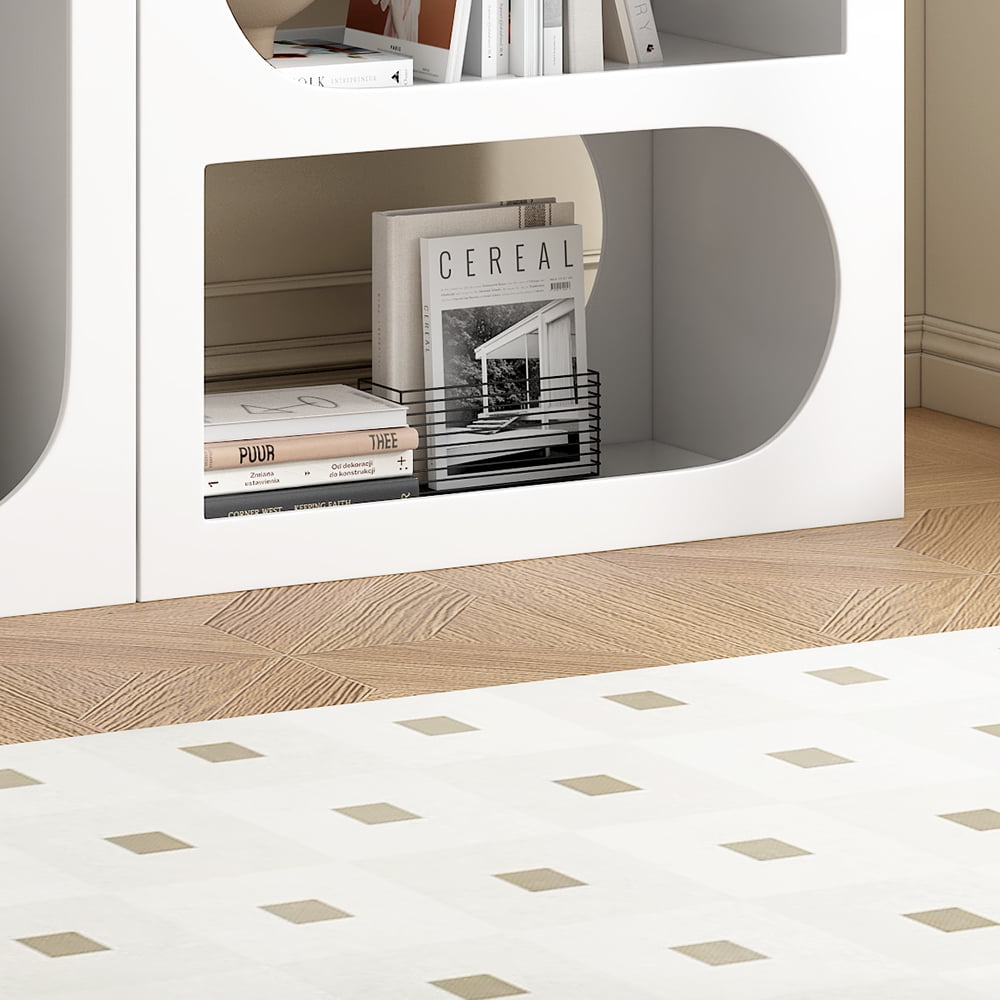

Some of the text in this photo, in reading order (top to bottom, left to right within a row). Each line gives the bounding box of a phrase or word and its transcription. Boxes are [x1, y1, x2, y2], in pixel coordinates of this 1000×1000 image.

[440, 239, 574, 280] CEREAL
[369, 431, 398, 450] THEE
[239, 444, 275, 464] PUUR
[331, 463, 342, 471] Od
